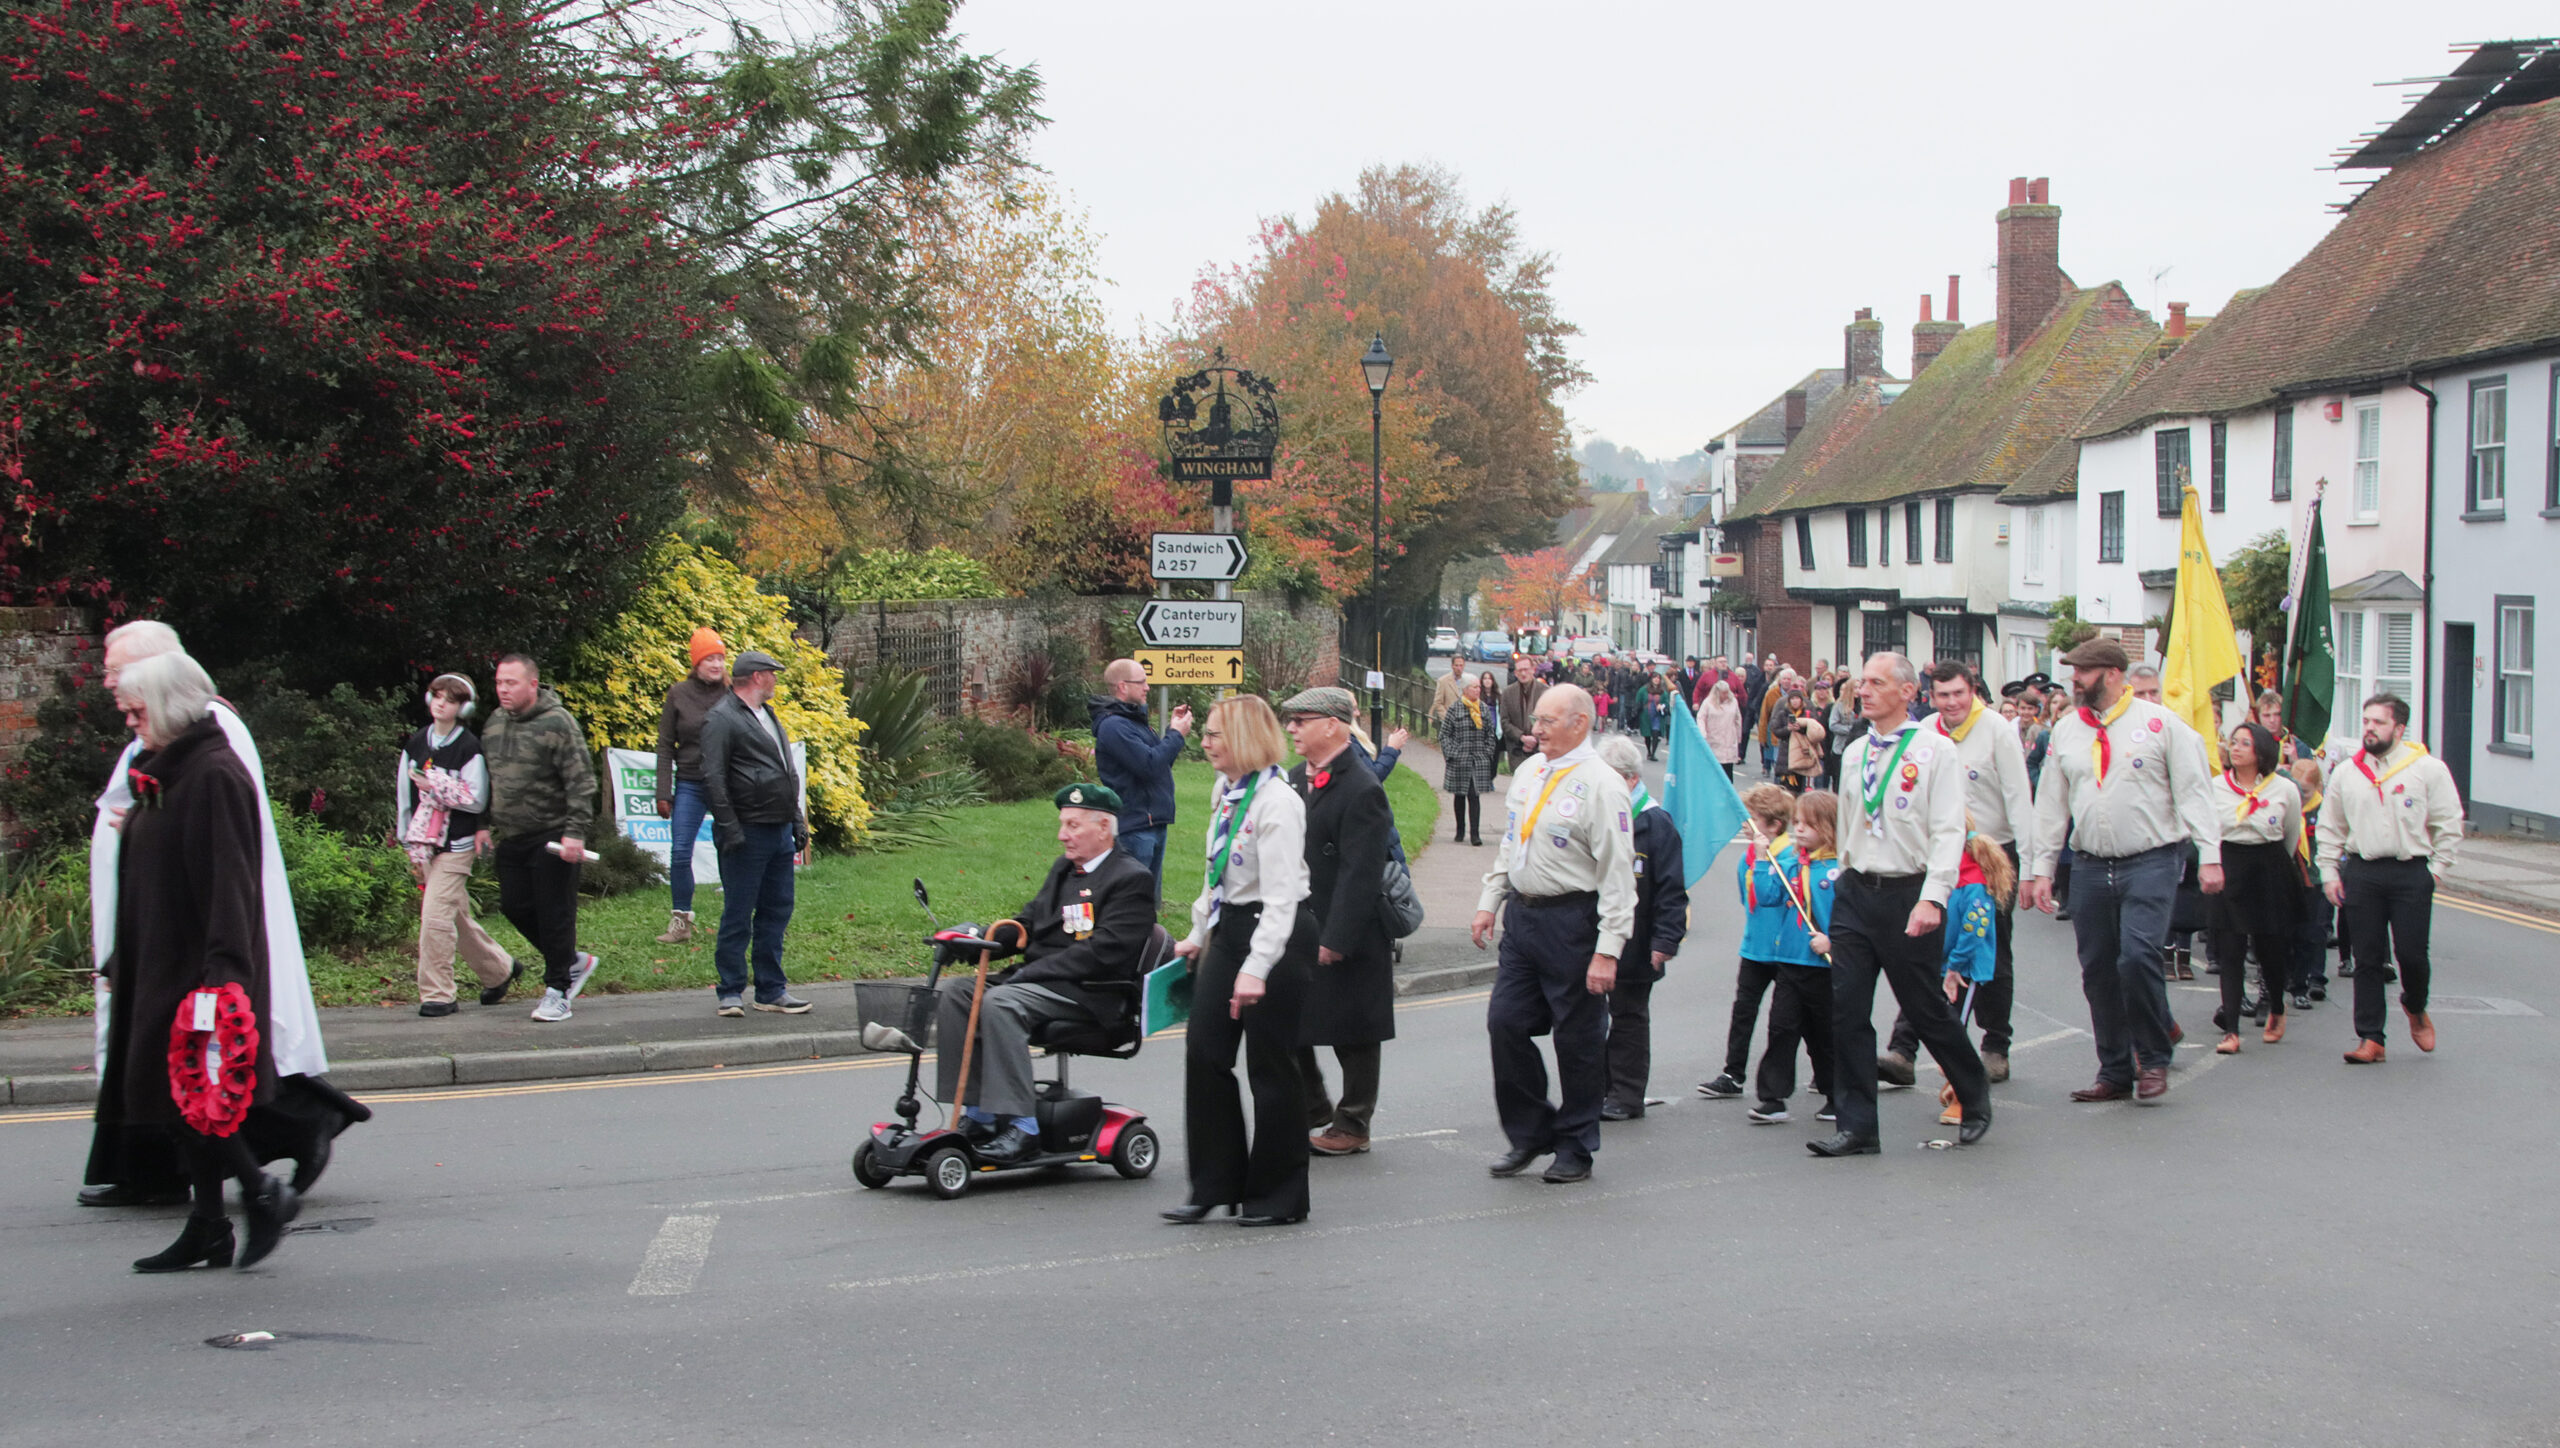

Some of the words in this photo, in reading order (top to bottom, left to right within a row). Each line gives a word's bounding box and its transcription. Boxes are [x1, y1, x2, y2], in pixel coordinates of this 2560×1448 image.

[1181, 462, 1264, 475] WINGHAM
[1158, 541, 1224, 554] Sandwich
[1161, 608, 1237, 623] Canterbury
[1166, 653, 1214, 664] Harfleet
[1165, 668, 1214, 678] Gardens
[629, 796, 658, 815] Saf
